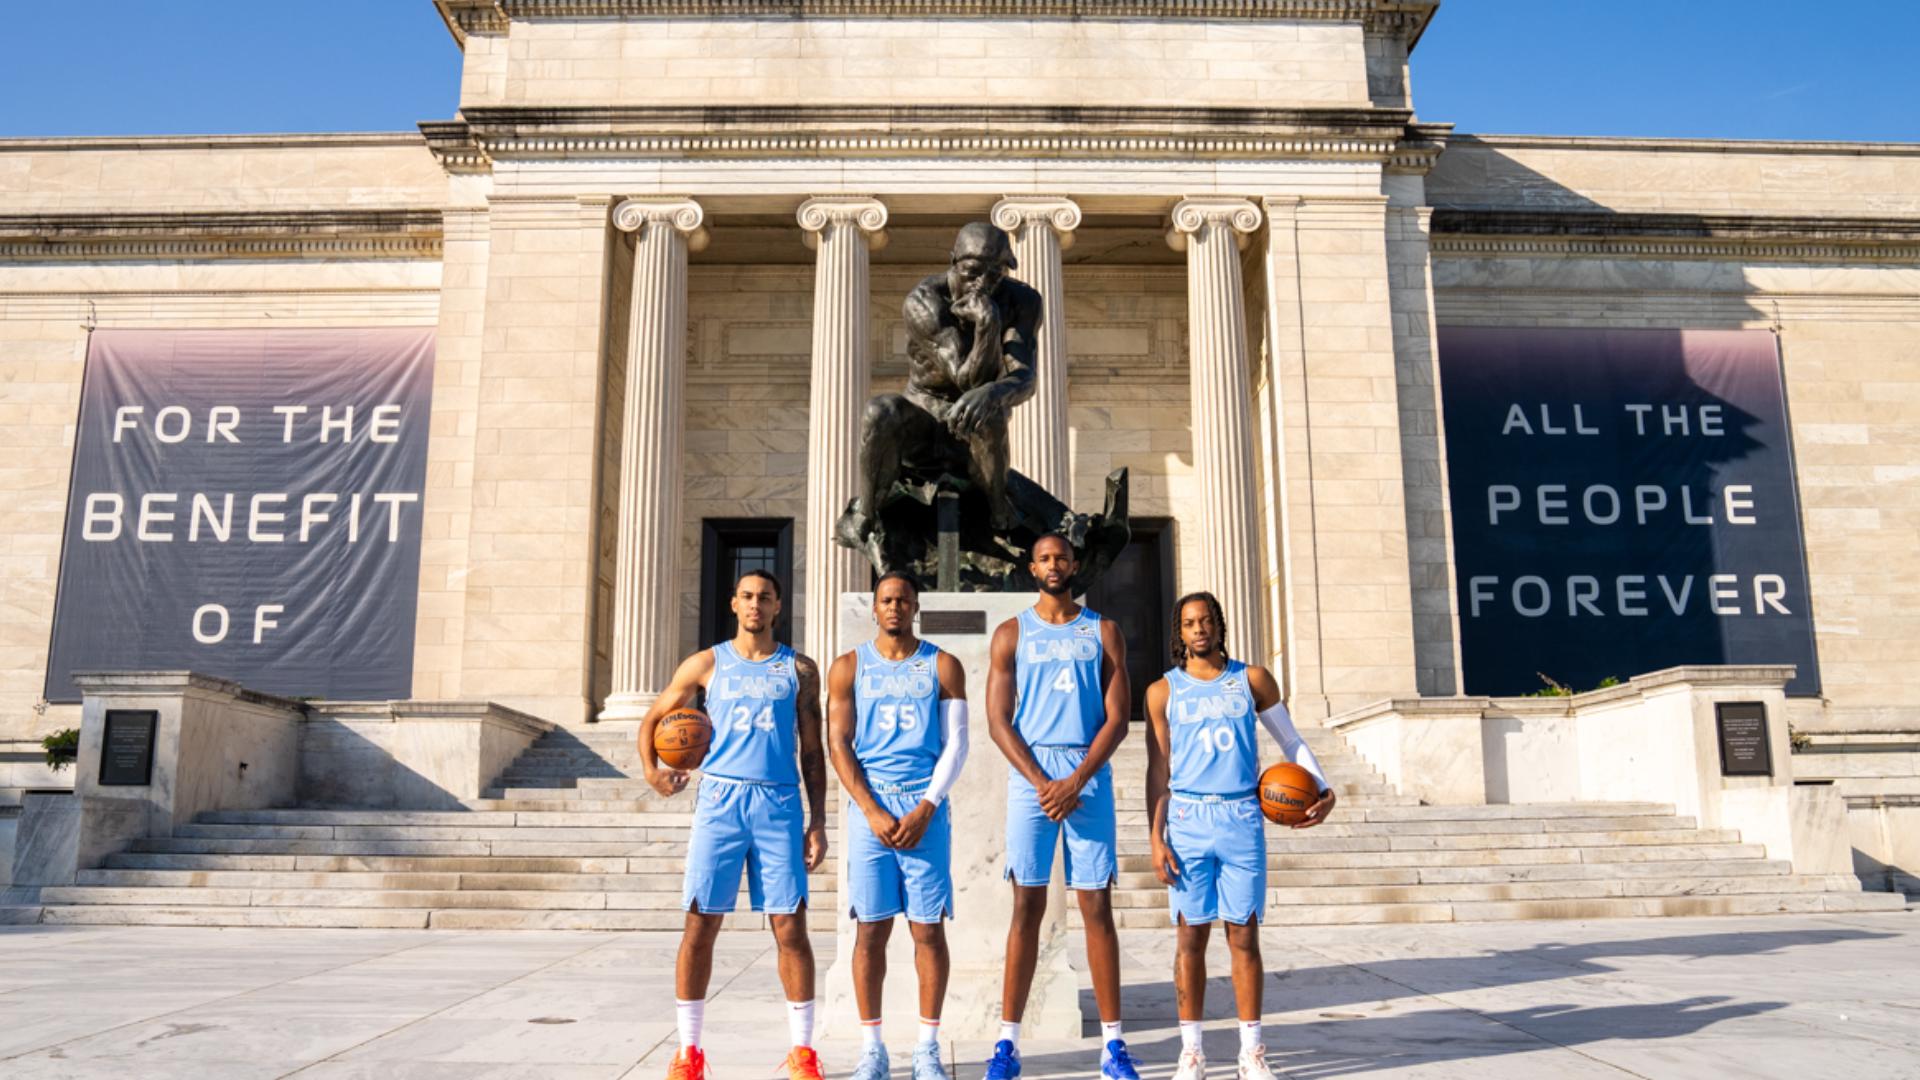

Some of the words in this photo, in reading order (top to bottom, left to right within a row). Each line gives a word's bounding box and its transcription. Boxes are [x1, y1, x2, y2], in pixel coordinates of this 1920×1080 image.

[113, 406, 241, 443] FOR
[273, 405, 401, 443] THE
[1502, 403, 1600, 435] ALL
[1625, 404, 1725, 436] THE
[82, 493, 418, 542] BENEFIT
[1487, 485, 1757, 525] PEOPLE
[1469, 573, 1792, 617] FOREVER
[192, 603, 284, 644] OF
[1028, 638, 1098, 664] LAND
[720, 675, 791, 700] LAND
[862, 675, 934, 699] LAND
[1053, 667, 1075, 693] 4
[731, 706, 775, 732] 24
[878, 703, 917, 731] 35
[1177, 694, 1249, 725] LAND
[1198, 726, 1236, 753] 10
